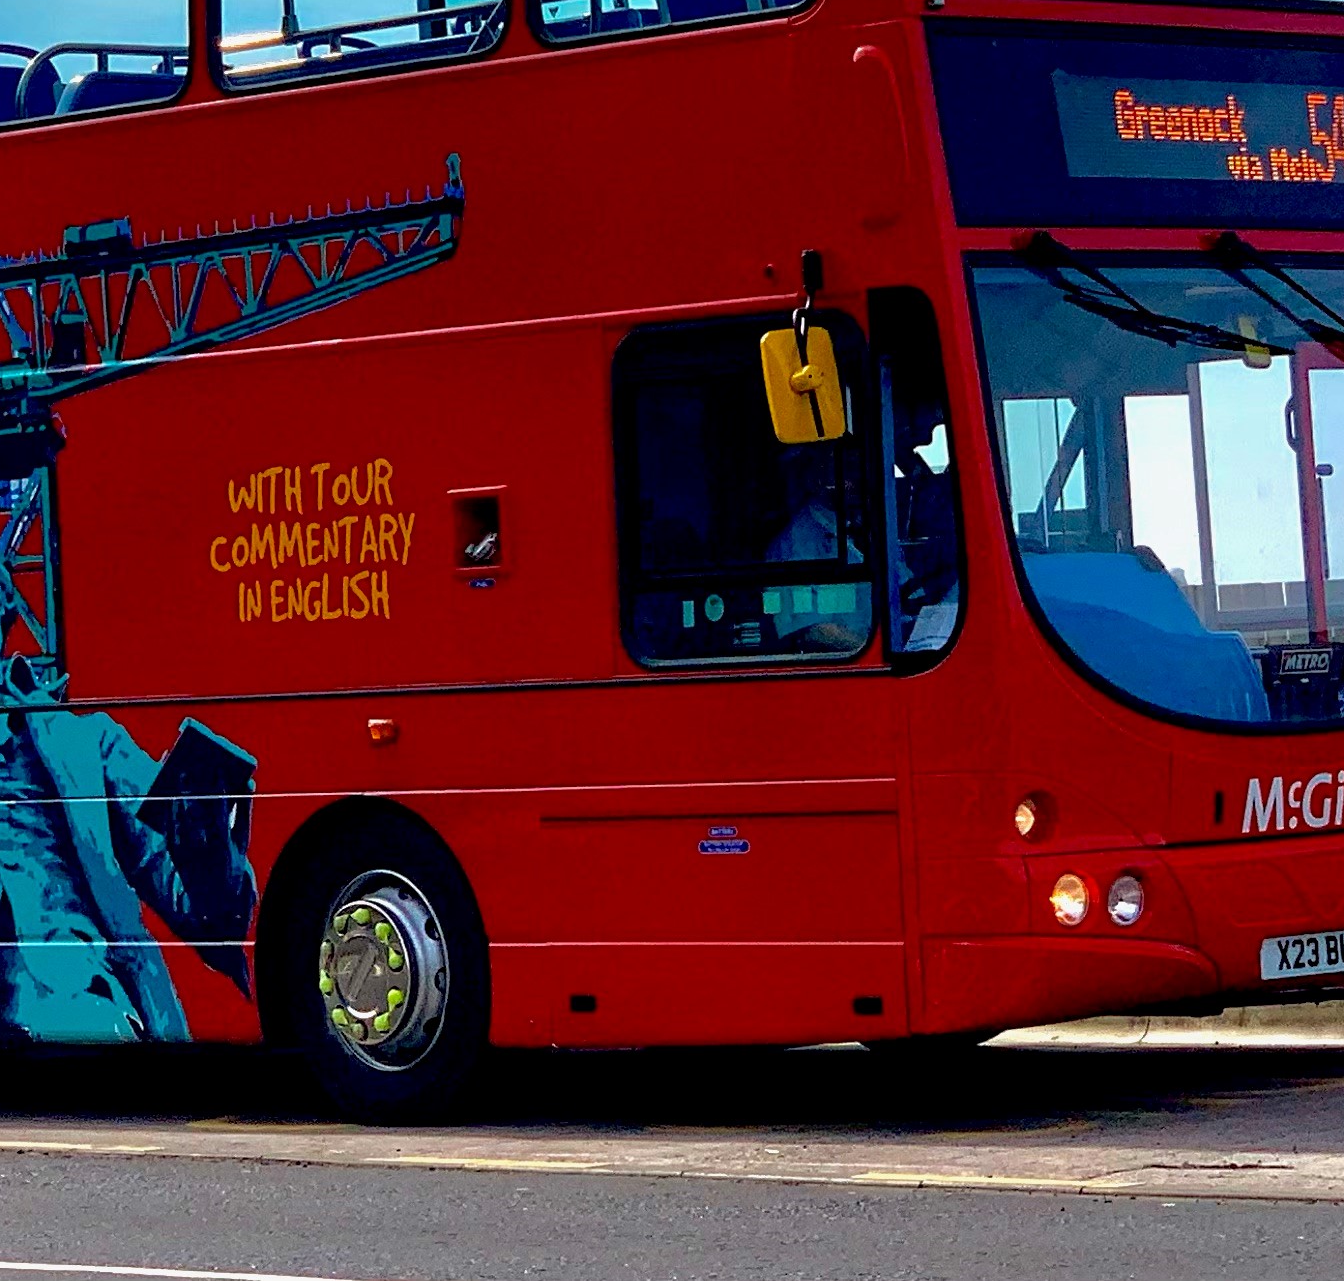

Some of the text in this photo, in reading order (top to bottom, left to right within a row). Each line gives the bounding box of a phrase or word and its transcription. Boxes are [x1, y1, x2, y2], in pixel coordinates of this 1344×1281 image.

[1114, 90, 1247, 142] Greenock
[1227, 147, 1263, 180] via
[228, 458, 394, 515] WITH TOUR
[210, 512, 415, 572] COMMENTARY
[238, 570, 390, 622] IN ENGLISH
[1284, 652, 1330, 670] METRO
[1277, 935, 1321, 971] X23
